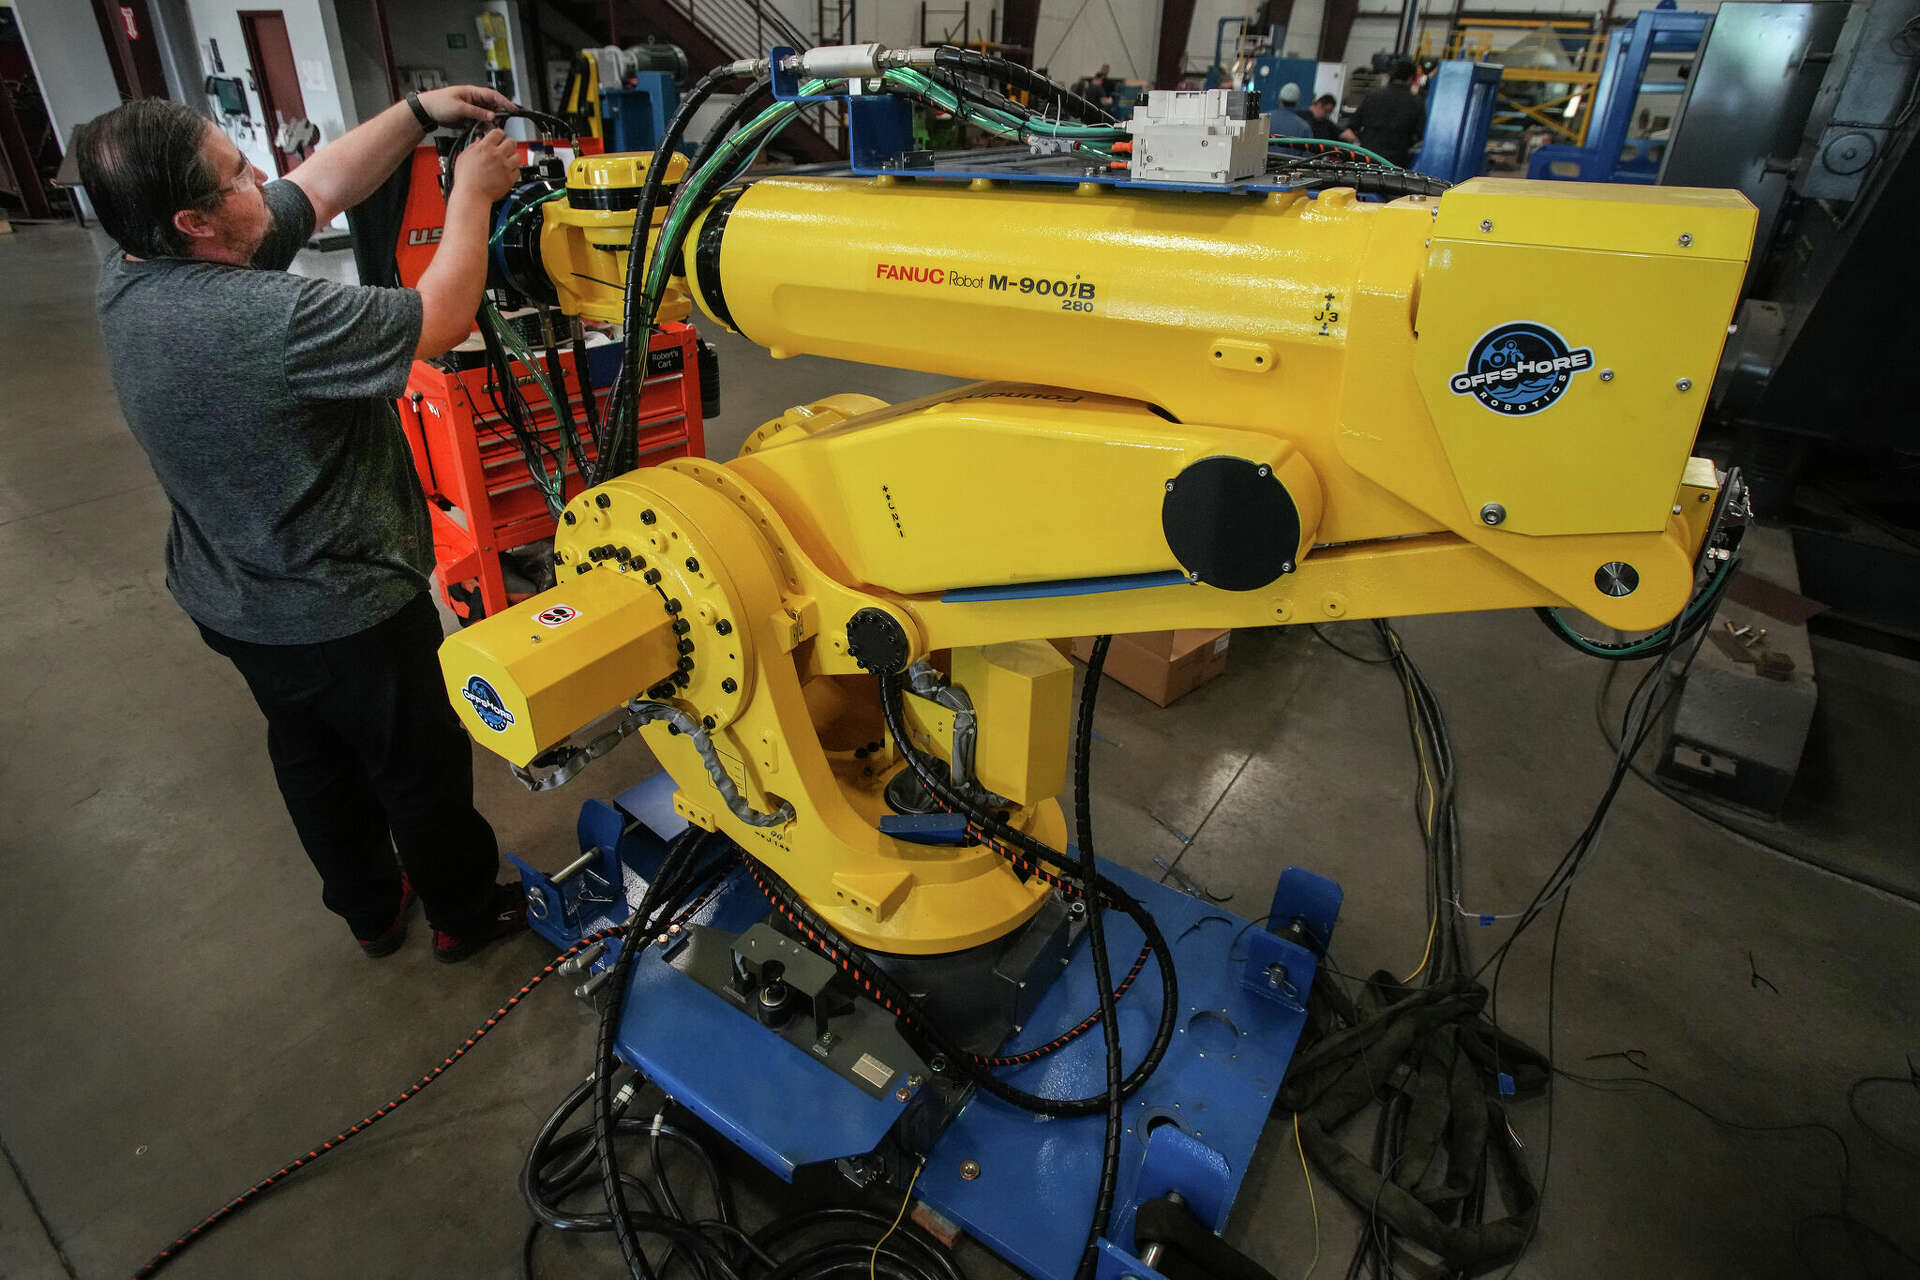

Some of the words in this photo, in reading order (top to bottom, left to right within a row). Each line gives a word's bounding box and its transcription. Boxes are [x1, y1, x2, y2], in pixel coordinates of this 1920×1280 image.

[876, 264, 944, 284] FANUC
[949, 271, 984, 289] Robot
[989, 274, 1096, 300] M-900iB
[1062, 300, 1094, 312] 280
[657, 360, 672, 369] Cart
[1454, 352, 1588, 390] OFFSHORE
[1480, 375, 1567, 411] ROBOTICS
[463, 690, 513, 722] OFFSHORE
